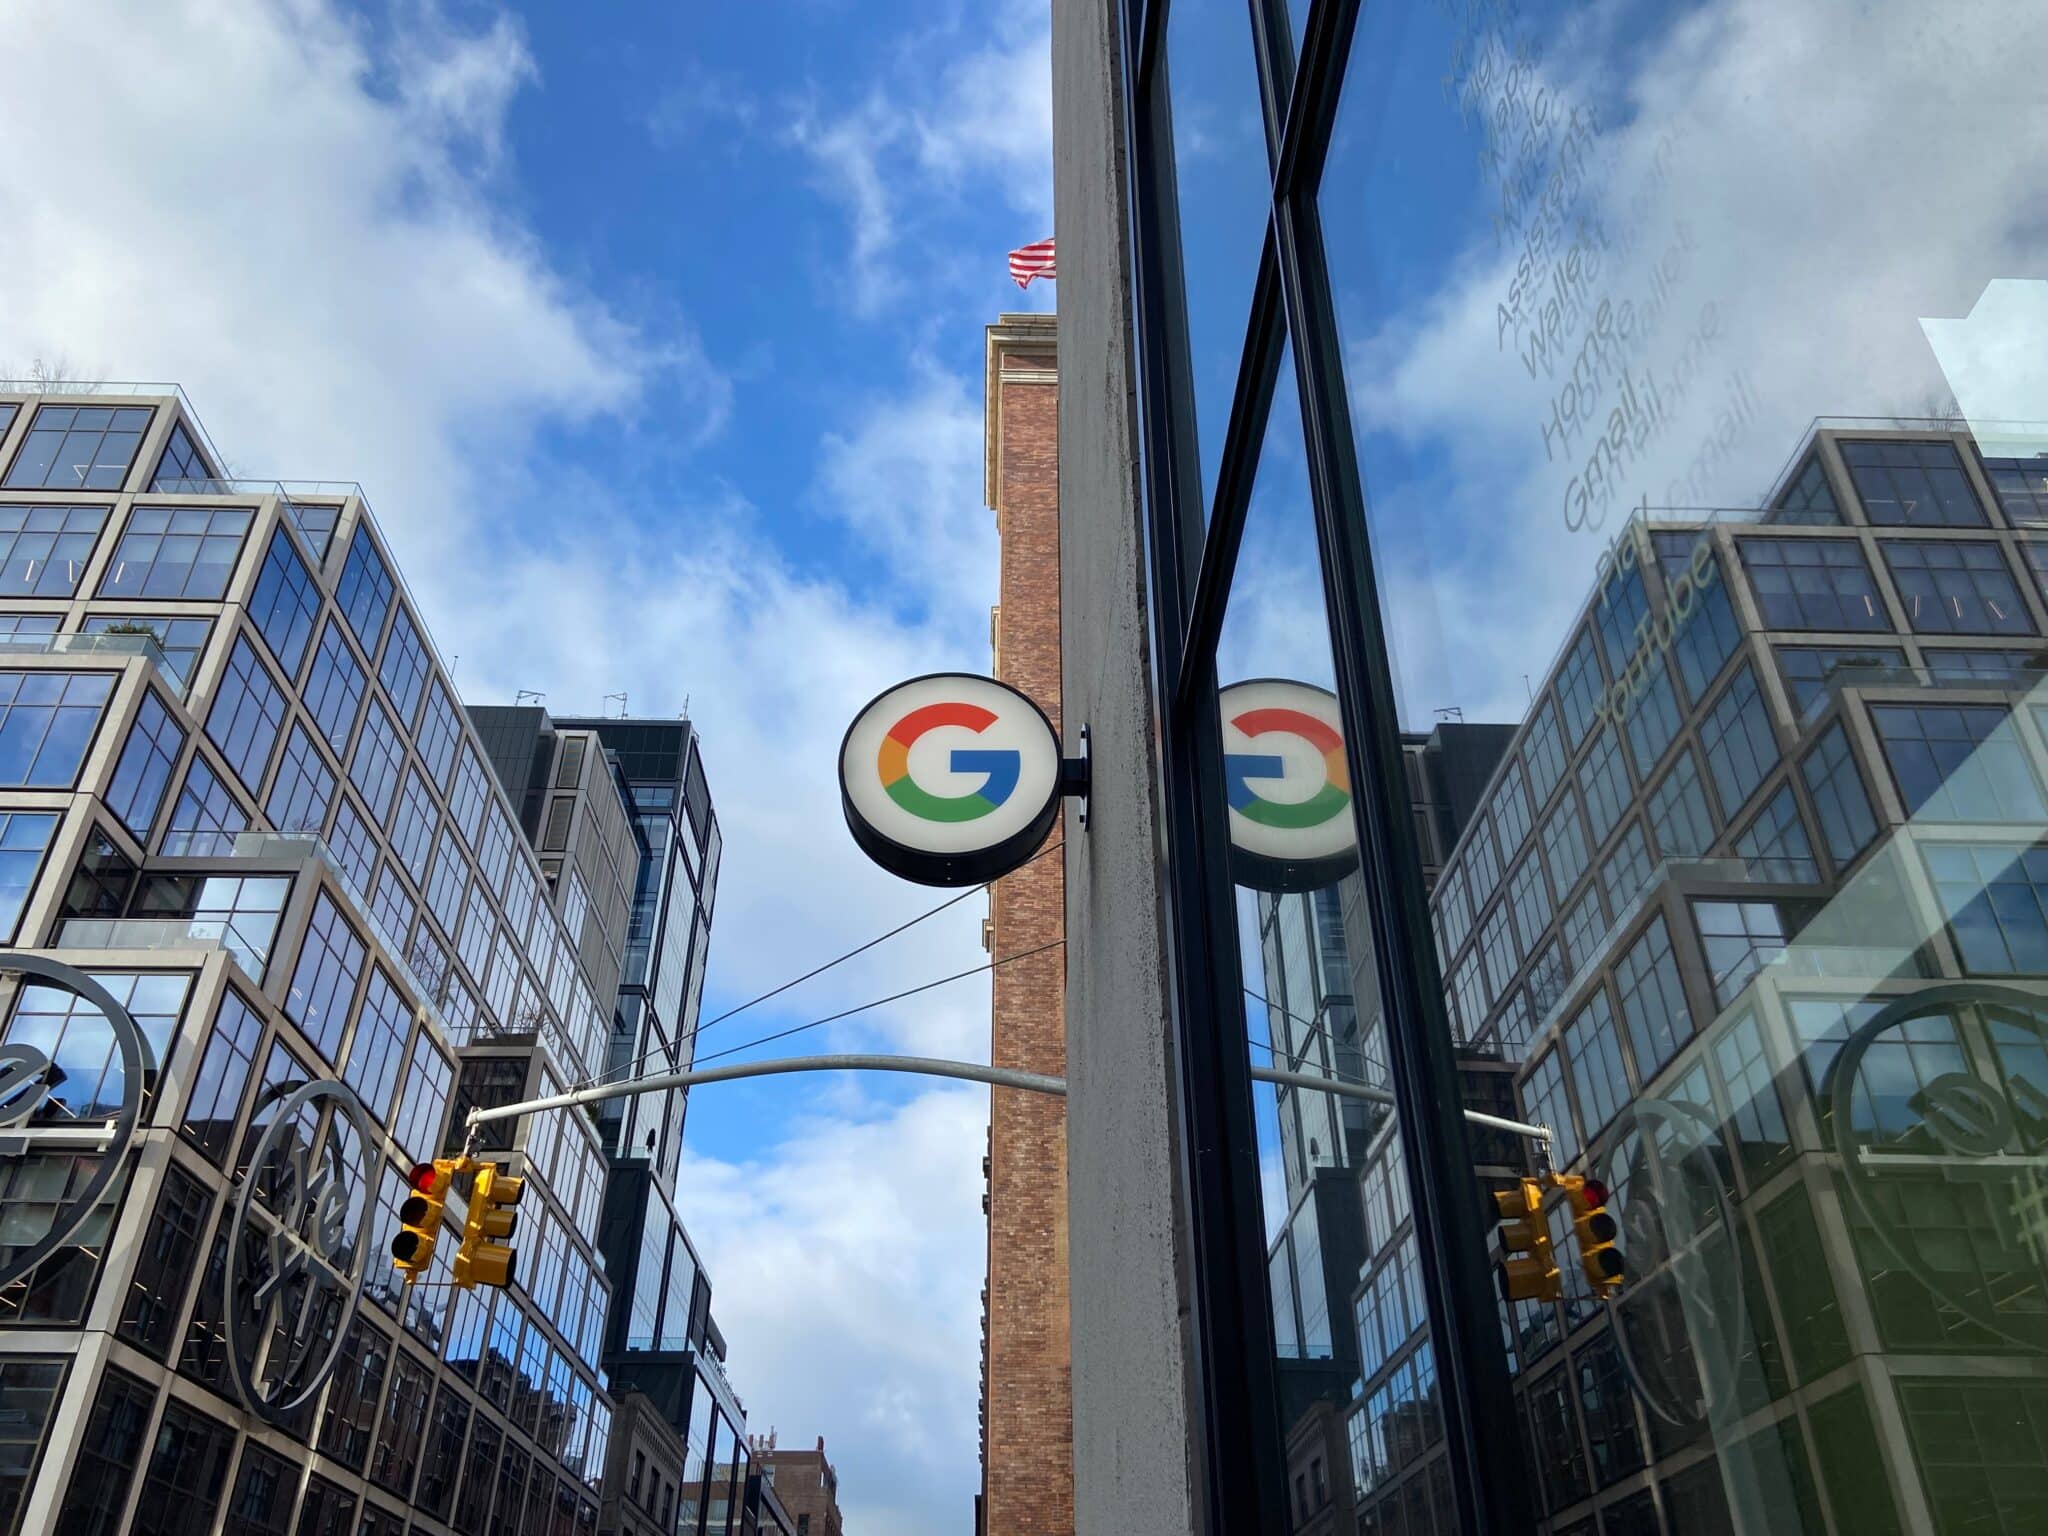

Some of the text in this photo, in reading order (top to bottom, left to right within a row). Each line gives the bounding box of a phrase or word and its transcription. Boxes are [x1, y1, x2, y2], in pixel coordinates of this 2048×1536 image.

[1498, 104, 1585, 353] Assistant
[1521, 218, 1591, 380] Wallet
[1542, 298, 1613, 462] Home
[1564, 367, 1638, 533] Gmail
[1593, 541, 1715, 725] YouTube
[877, 702, 1021, 823] G
